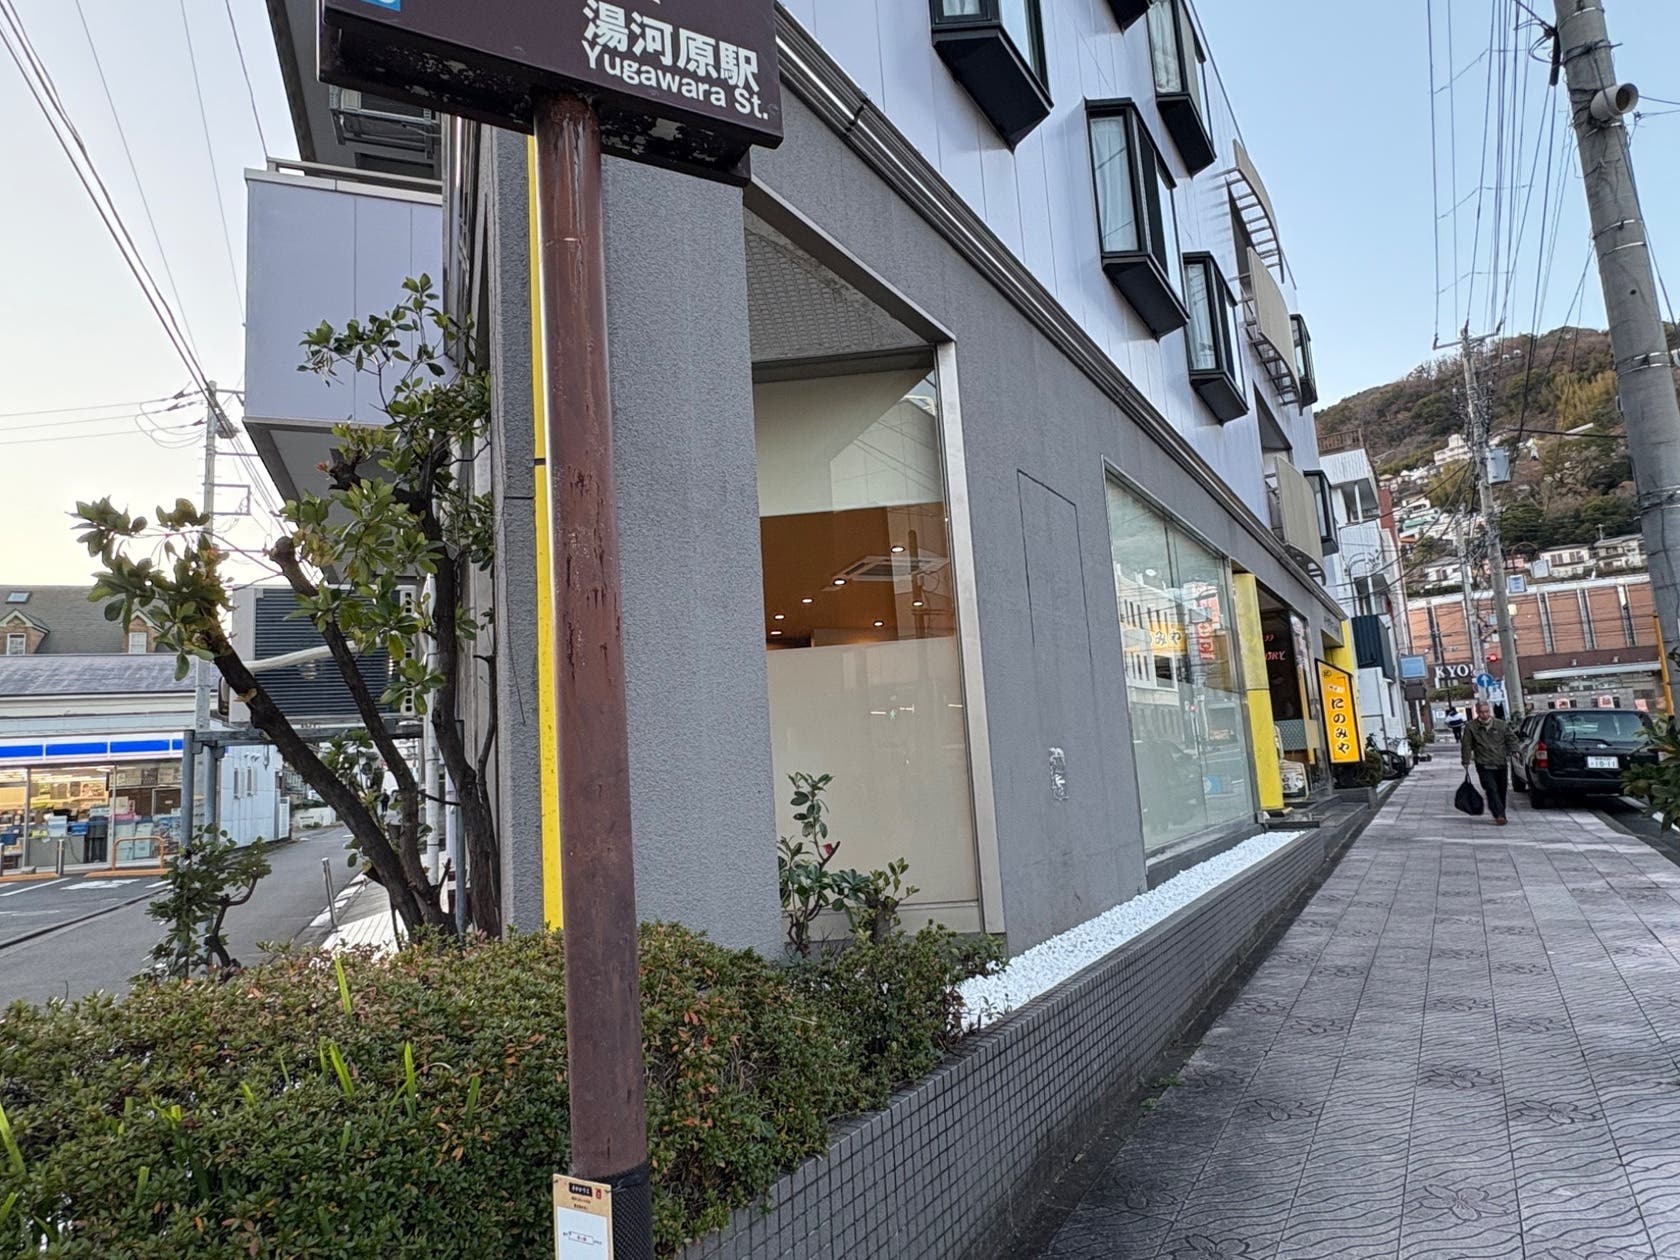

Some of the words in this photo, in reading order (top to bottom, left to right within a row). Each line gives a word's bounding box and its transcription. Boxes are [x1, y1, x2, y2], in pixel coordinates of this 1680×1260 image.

[581, 40, 727, 108] Yugawara
[734, 87, 769, 120] St.
[582, 0, 759, 93] 湯河原駅
[1331, 698, 1350, 754] にのみや
